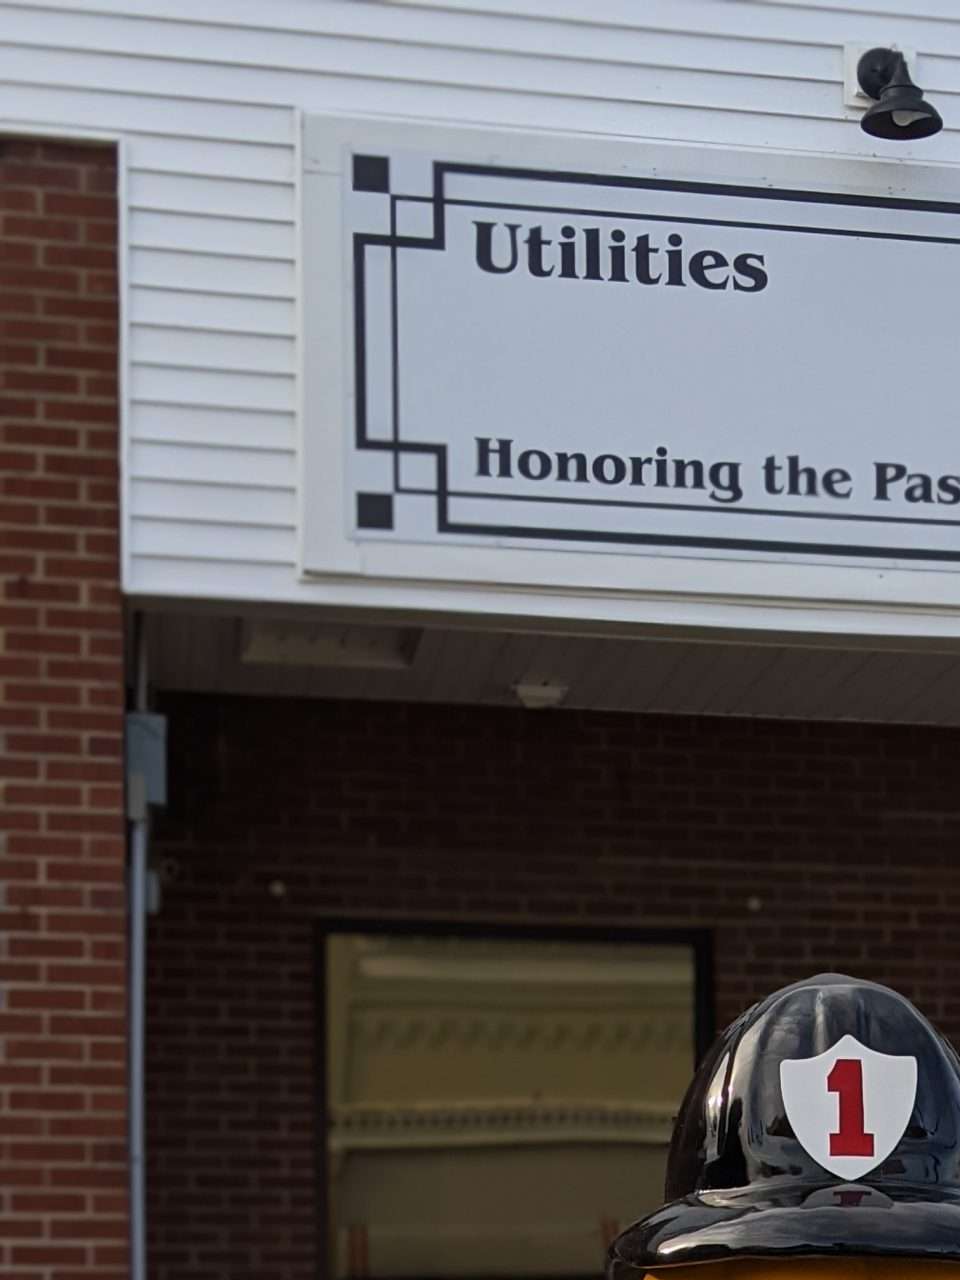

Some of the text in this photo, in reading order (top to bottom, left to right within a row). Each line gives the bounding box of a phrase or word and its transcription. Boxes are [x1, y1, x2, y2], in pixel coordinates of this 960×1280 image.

[473, 220, 767, 292] Utilities
[475, 438, 743, 504] Honoring
[762, 455, 852, 499] the
[827, 1058, 875, 1157] 1
